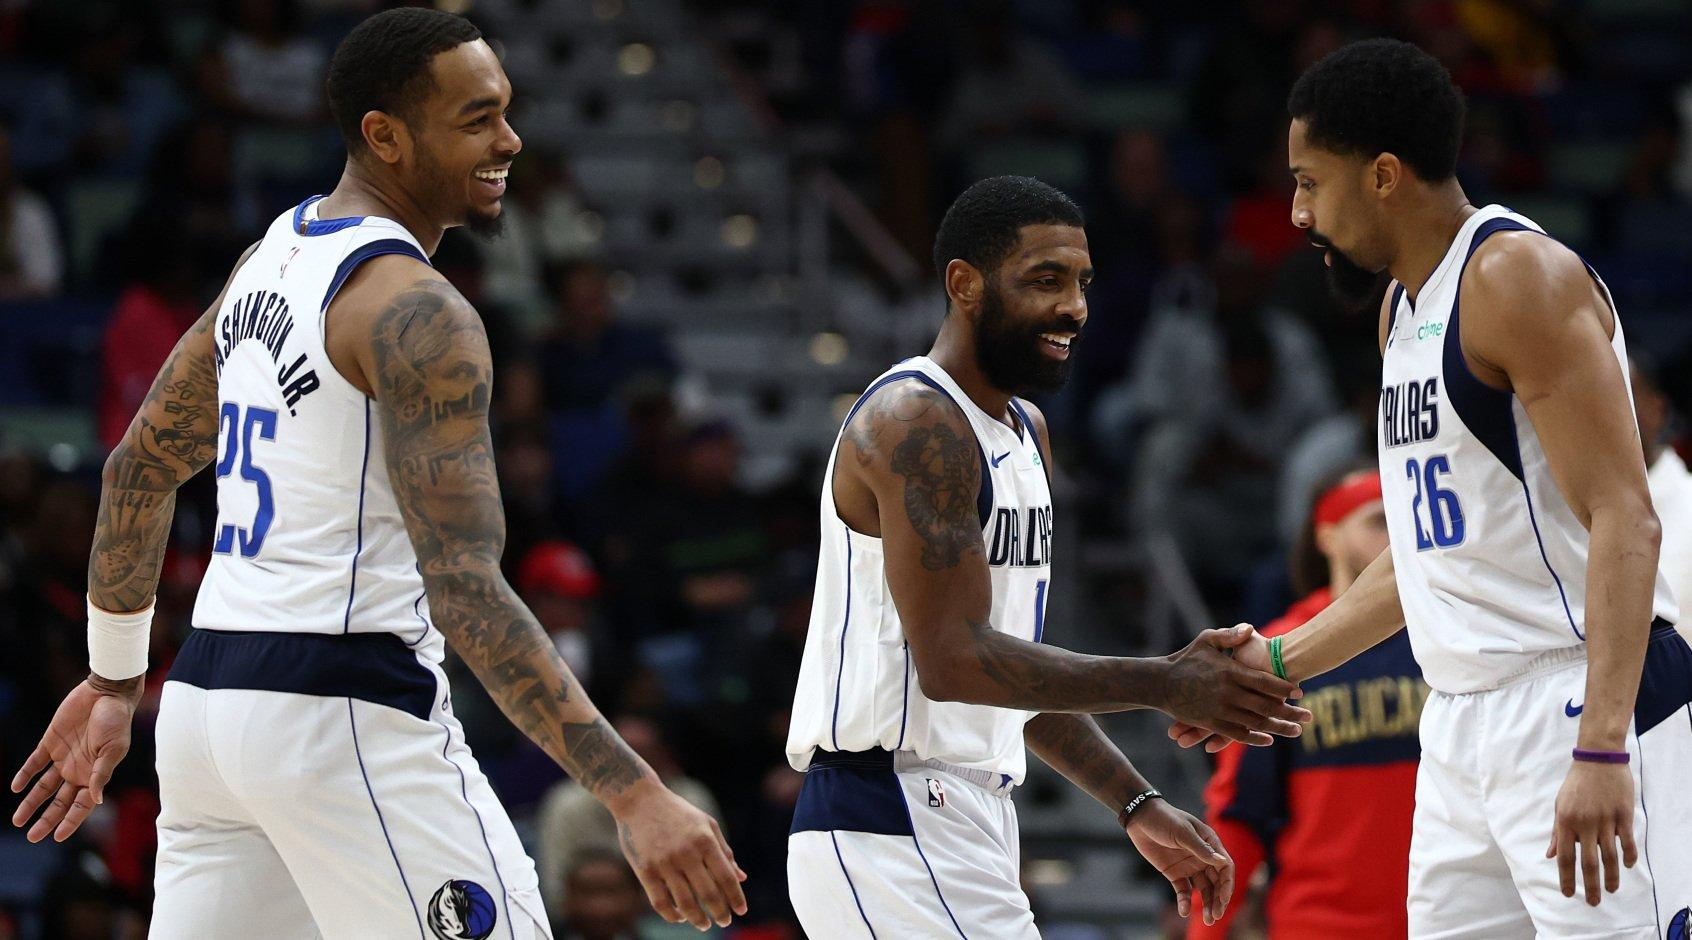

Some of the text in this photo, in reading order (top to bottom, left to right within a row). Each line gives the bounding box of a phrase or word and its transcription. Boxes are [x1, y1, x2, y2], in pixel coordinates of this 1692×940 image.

[215, 290, 320, 417] ASHINGTON JR.
[213, 400, 279, 560] 25
[1406, 454, 1466, 552] 26
[1033, 578, 1047, 643] 1
[1125, 793, 1146, 814] SAVE
